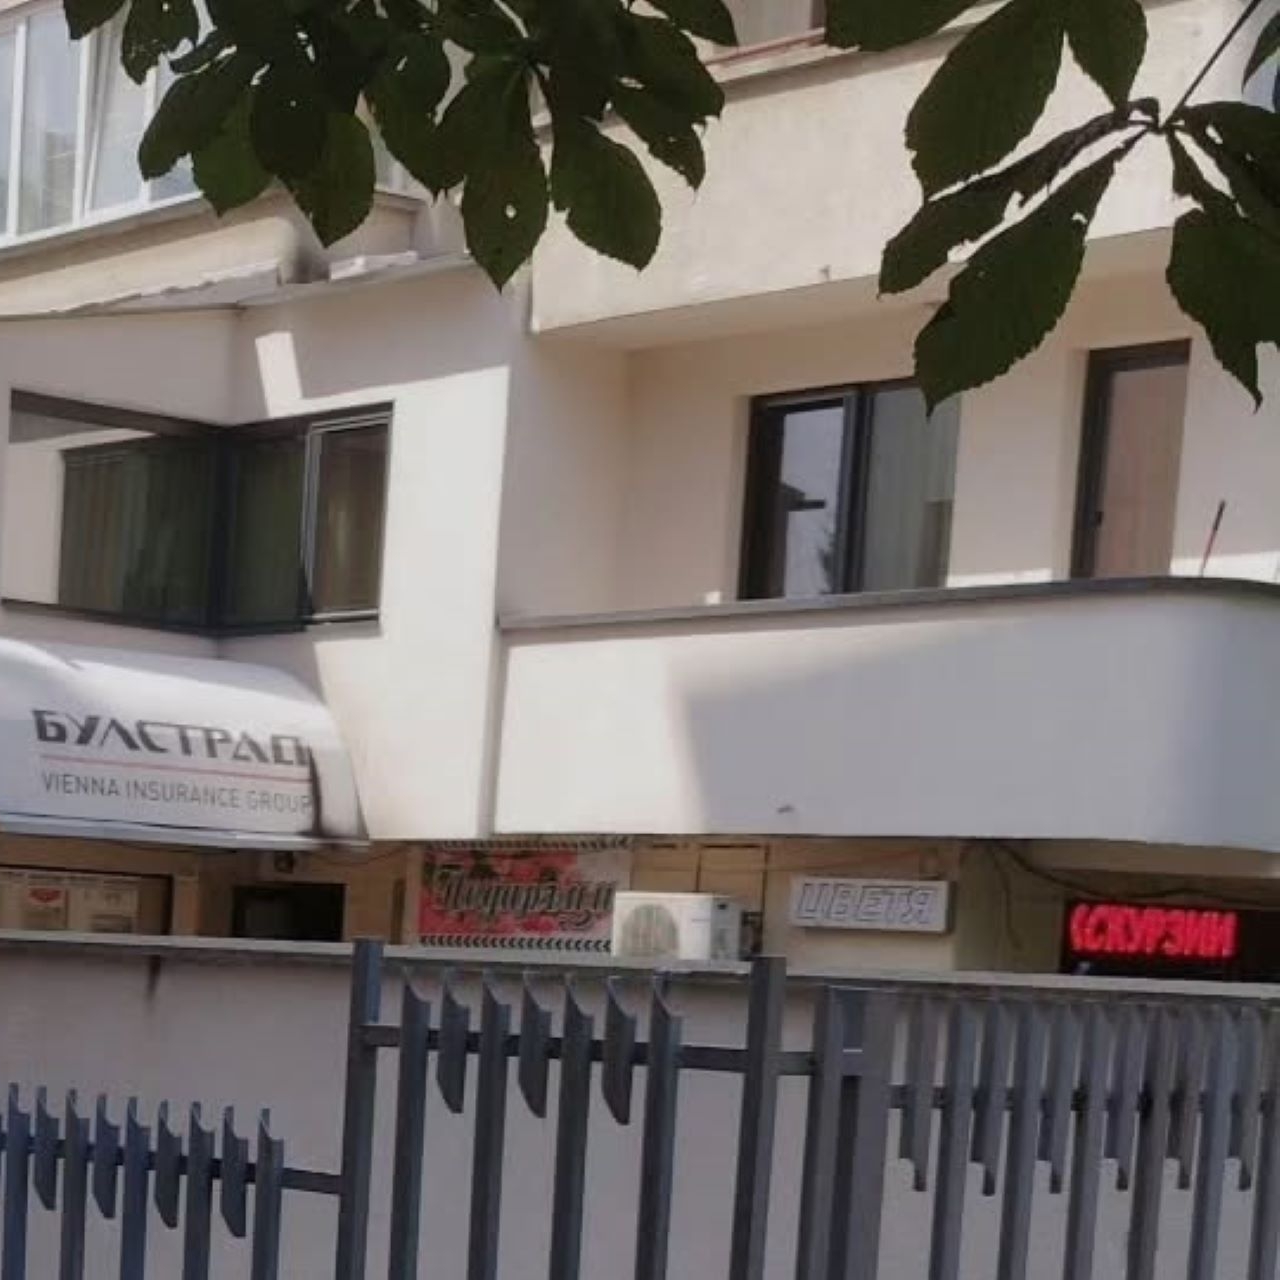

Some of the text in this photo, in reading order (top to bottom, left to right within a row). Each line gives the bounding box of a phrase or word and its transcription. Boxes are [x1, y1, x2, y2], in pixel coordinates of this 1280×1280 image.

[42, 773, 312, 815] VIENNA INSURANCE GROUP
[796, 882, 936, 924] ЦВЕТЯ
